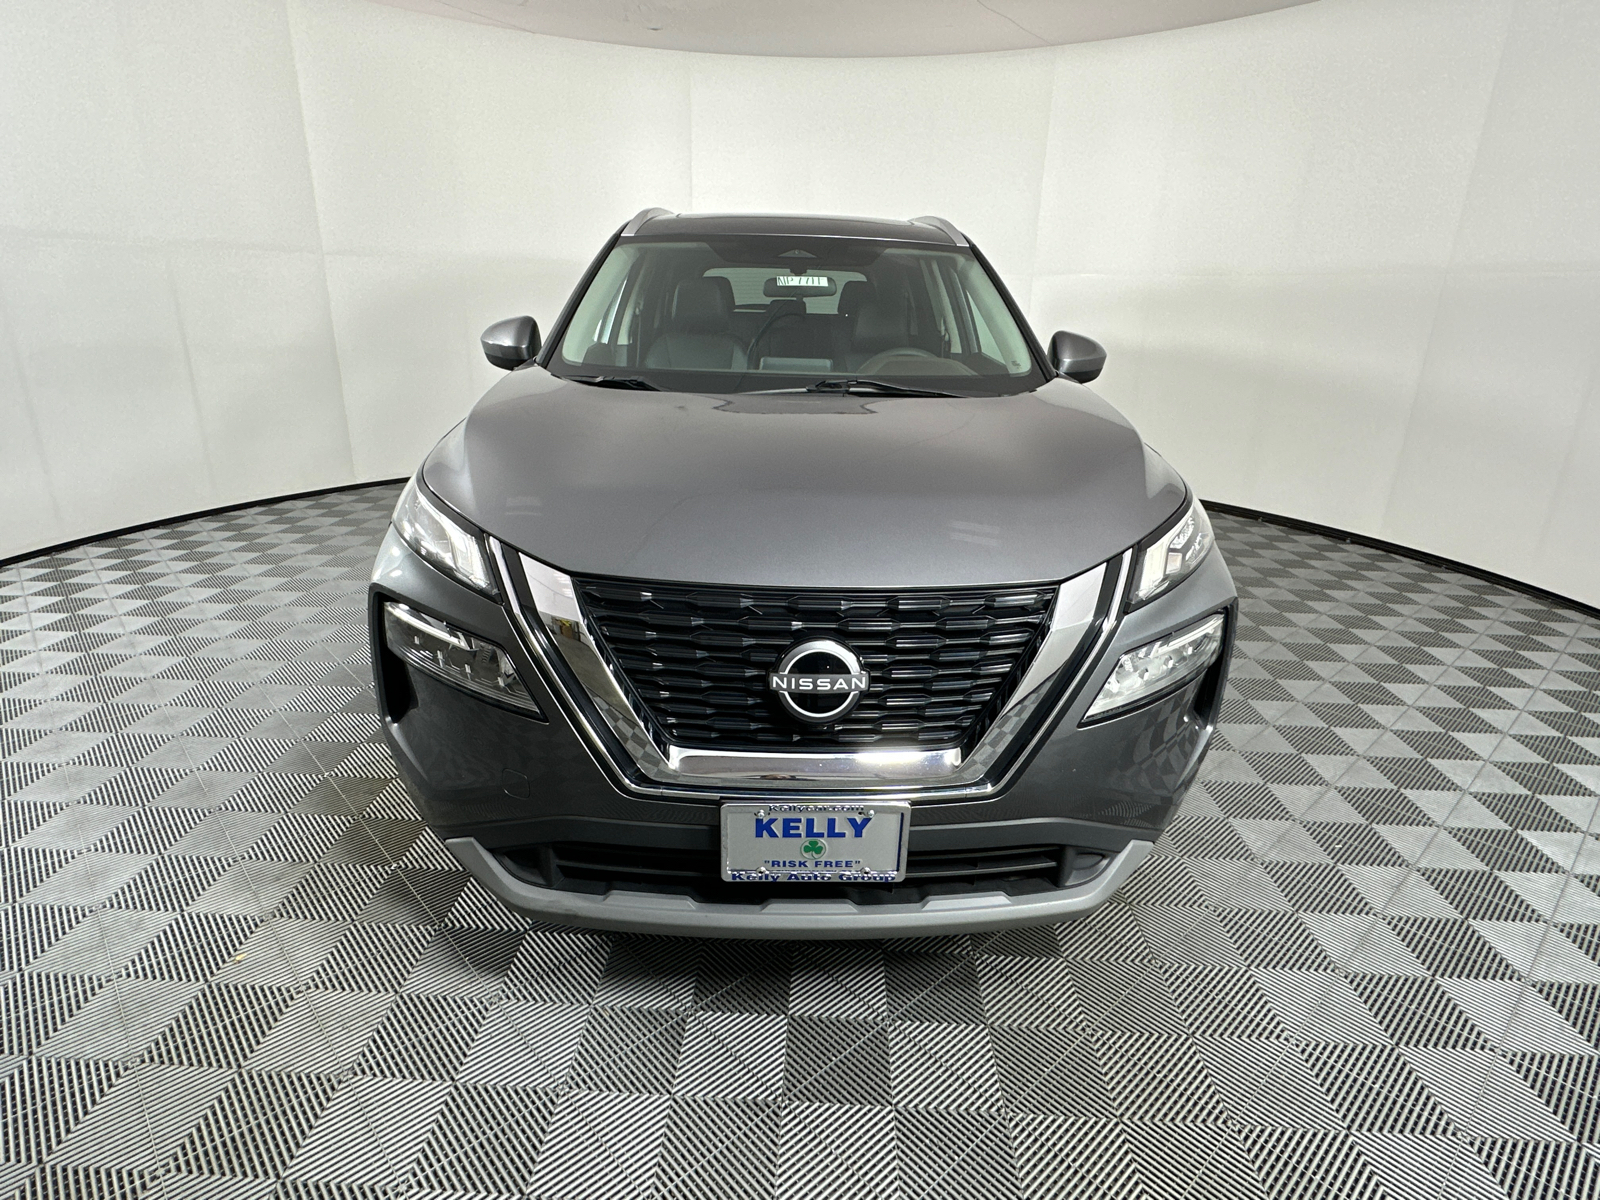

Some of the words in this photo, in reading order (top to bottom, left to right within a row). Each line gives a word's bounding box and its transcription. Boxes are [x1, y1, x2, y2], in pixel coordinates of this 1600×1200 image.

[772, 676, 865, 690] NISSAN
[755, 817, 872, 838] KELLY
[764, 860, 809, 868] "RISK
[814, 860, 860, 868] FREE"
[731, 872, 780, 883] Kelly
[786, 872, 832, 881] Auto
[838, 872, 896, 882] Group
